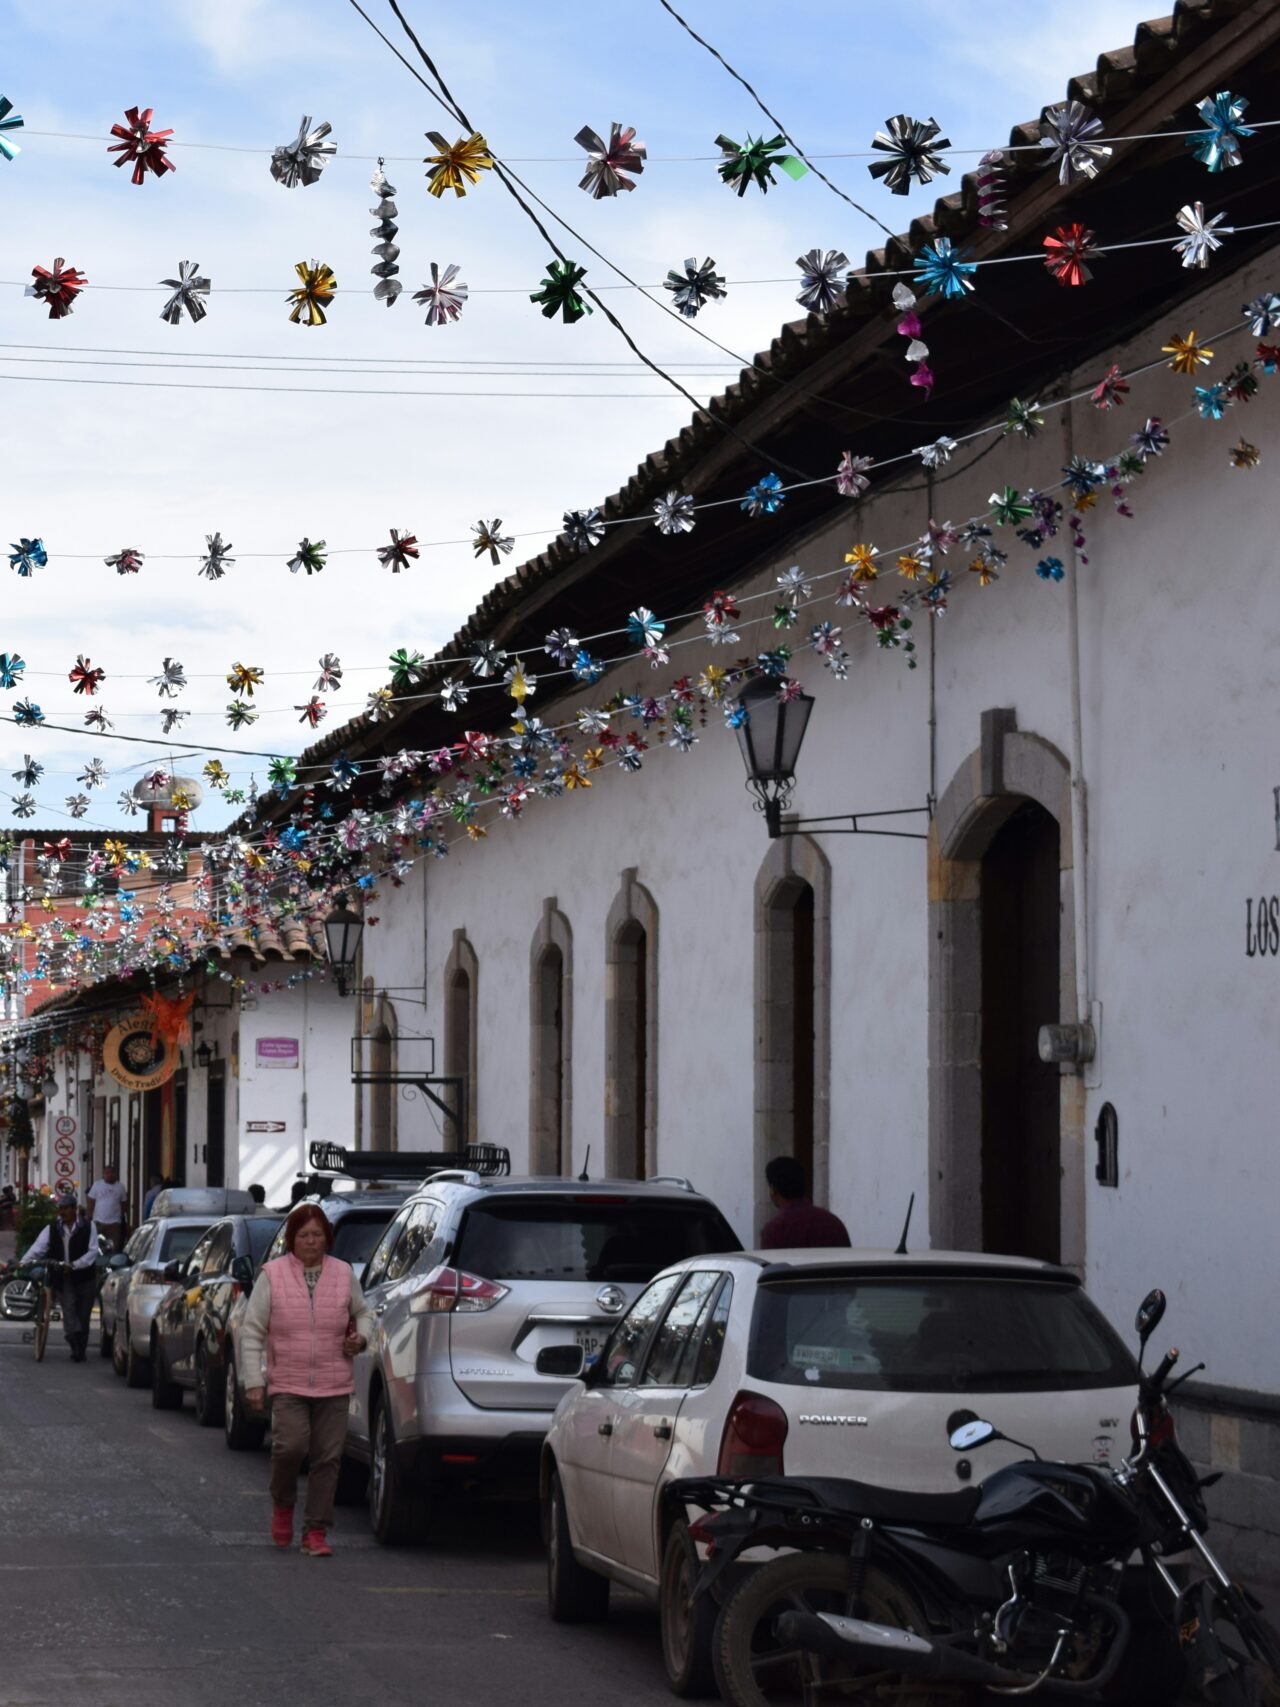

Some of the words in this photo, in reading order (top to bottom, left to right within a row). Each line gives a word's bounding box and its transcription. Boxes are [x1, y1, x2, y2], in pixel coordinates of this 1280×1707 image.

[1246, 895, 1280, 957] LOS
[118, 1018, 154, 1036] Alegr
[799, 1414, 868, 1426] POINTER
